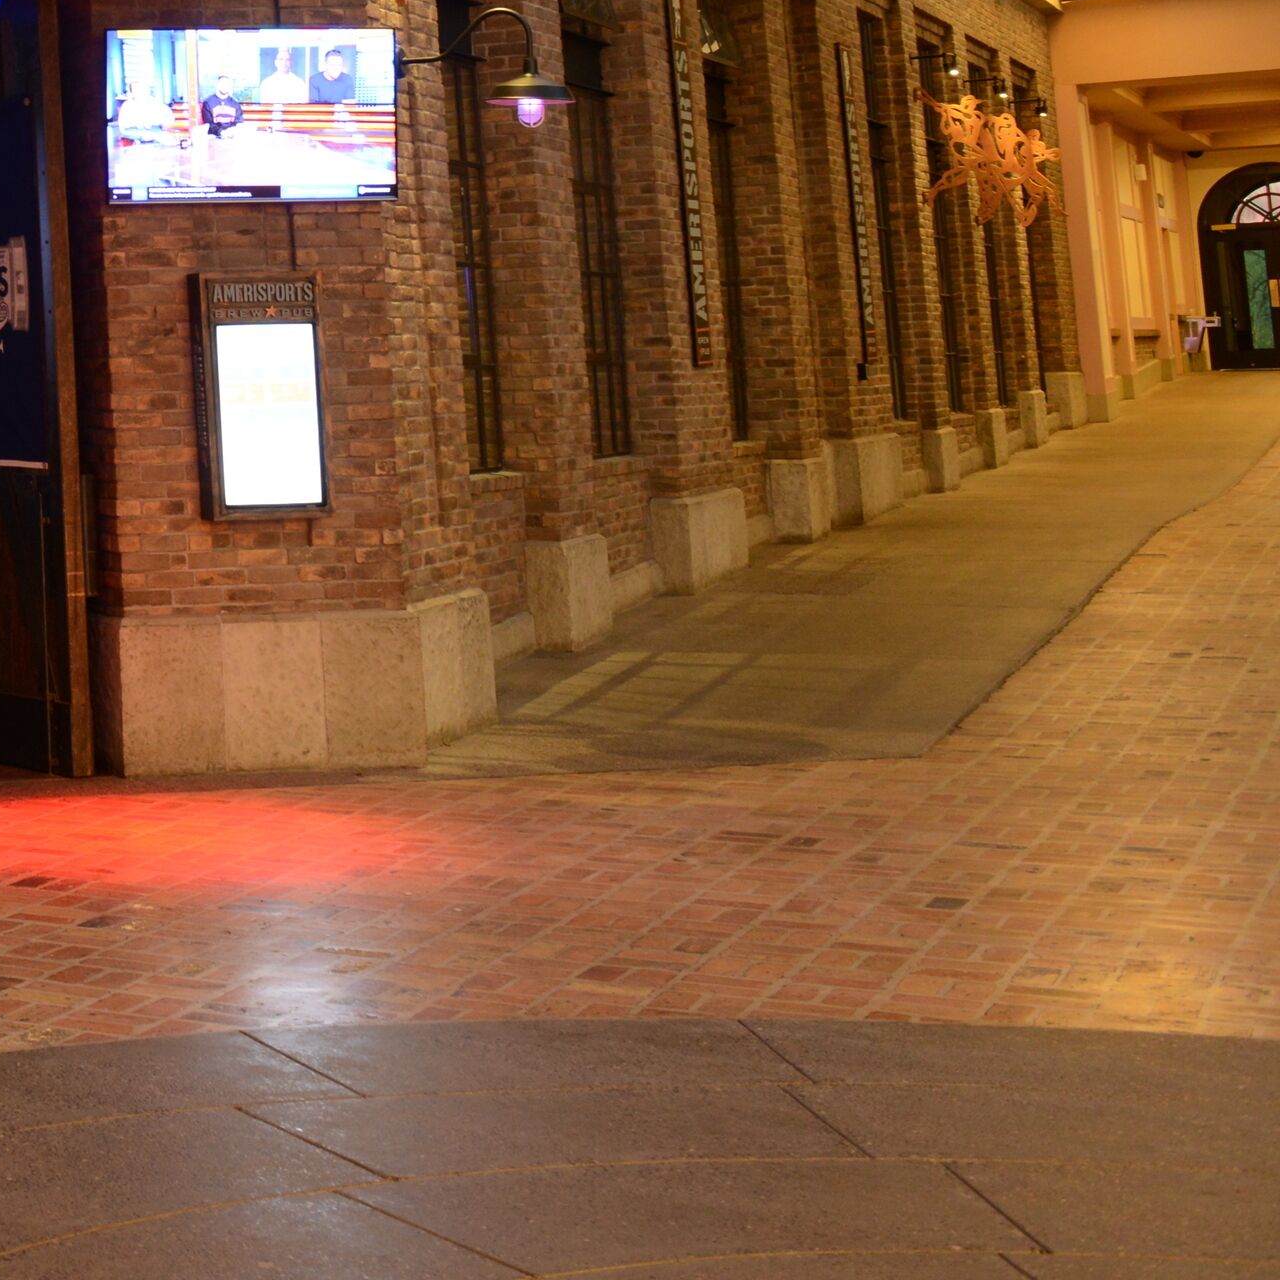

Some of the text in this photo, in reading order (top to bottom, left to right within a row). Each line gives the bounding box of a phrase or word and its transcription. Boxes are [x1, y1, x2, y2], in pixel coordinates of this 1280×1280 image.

[676, 49, 708, 322] AMERISPORTS
[846, 103, 874, 324] AMERISPORTS
[213, 282, 314, 303] AMERISPORTS
[215, 307, 313, 318] BREW PUB
